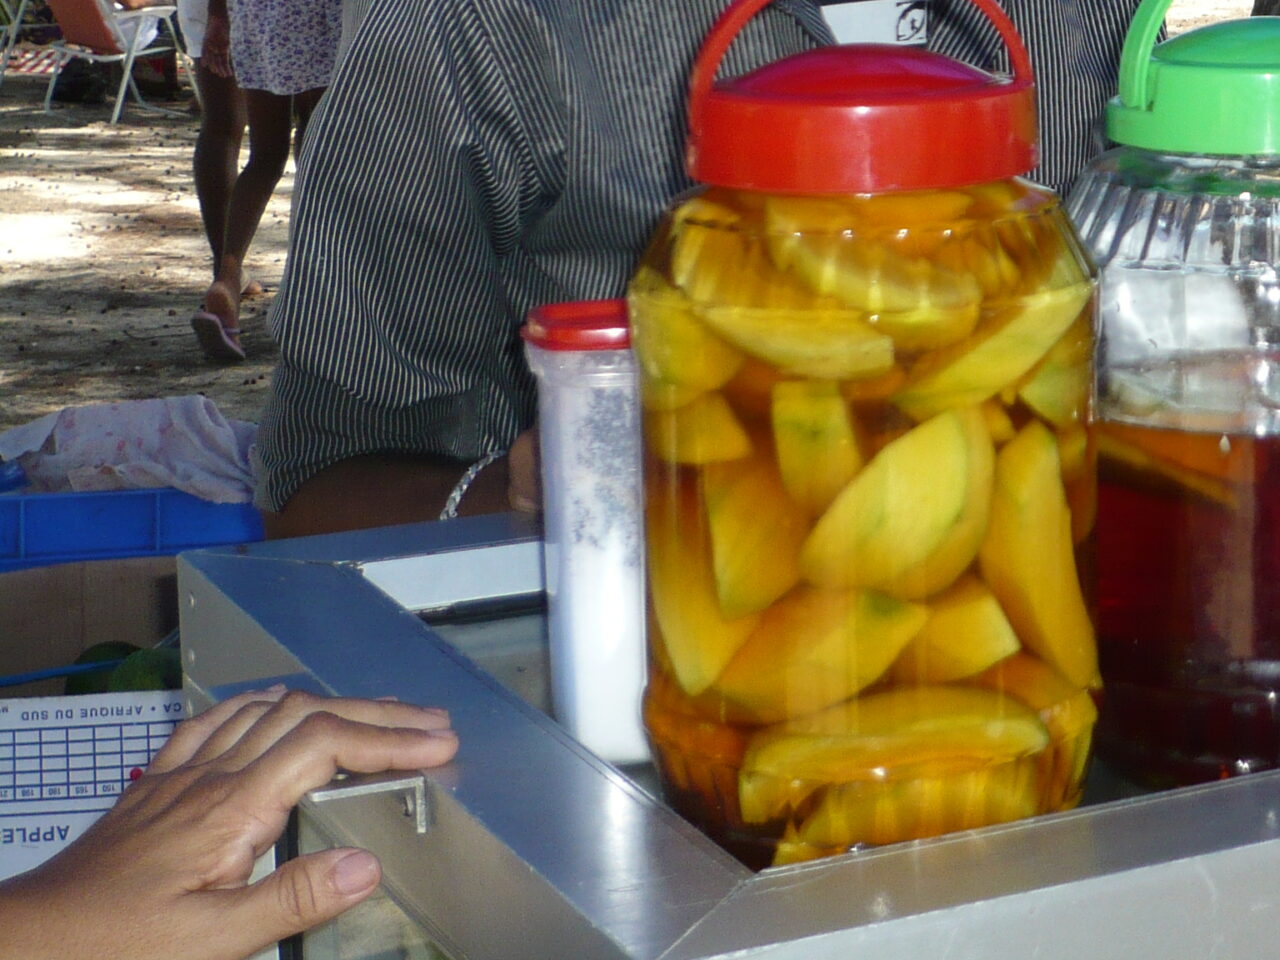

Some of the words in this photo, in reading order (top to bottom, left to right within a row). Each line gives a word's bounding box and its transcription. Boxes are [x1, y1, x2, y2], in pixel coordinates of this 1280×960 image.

[55, 708, 74, 720] DU
[80, 704, 143, 719] AFRIQUE
[163, 702, 182, 714] CA
[21, 709, 48, 722] SUD
[0, 825, 70, 844] APPLE
